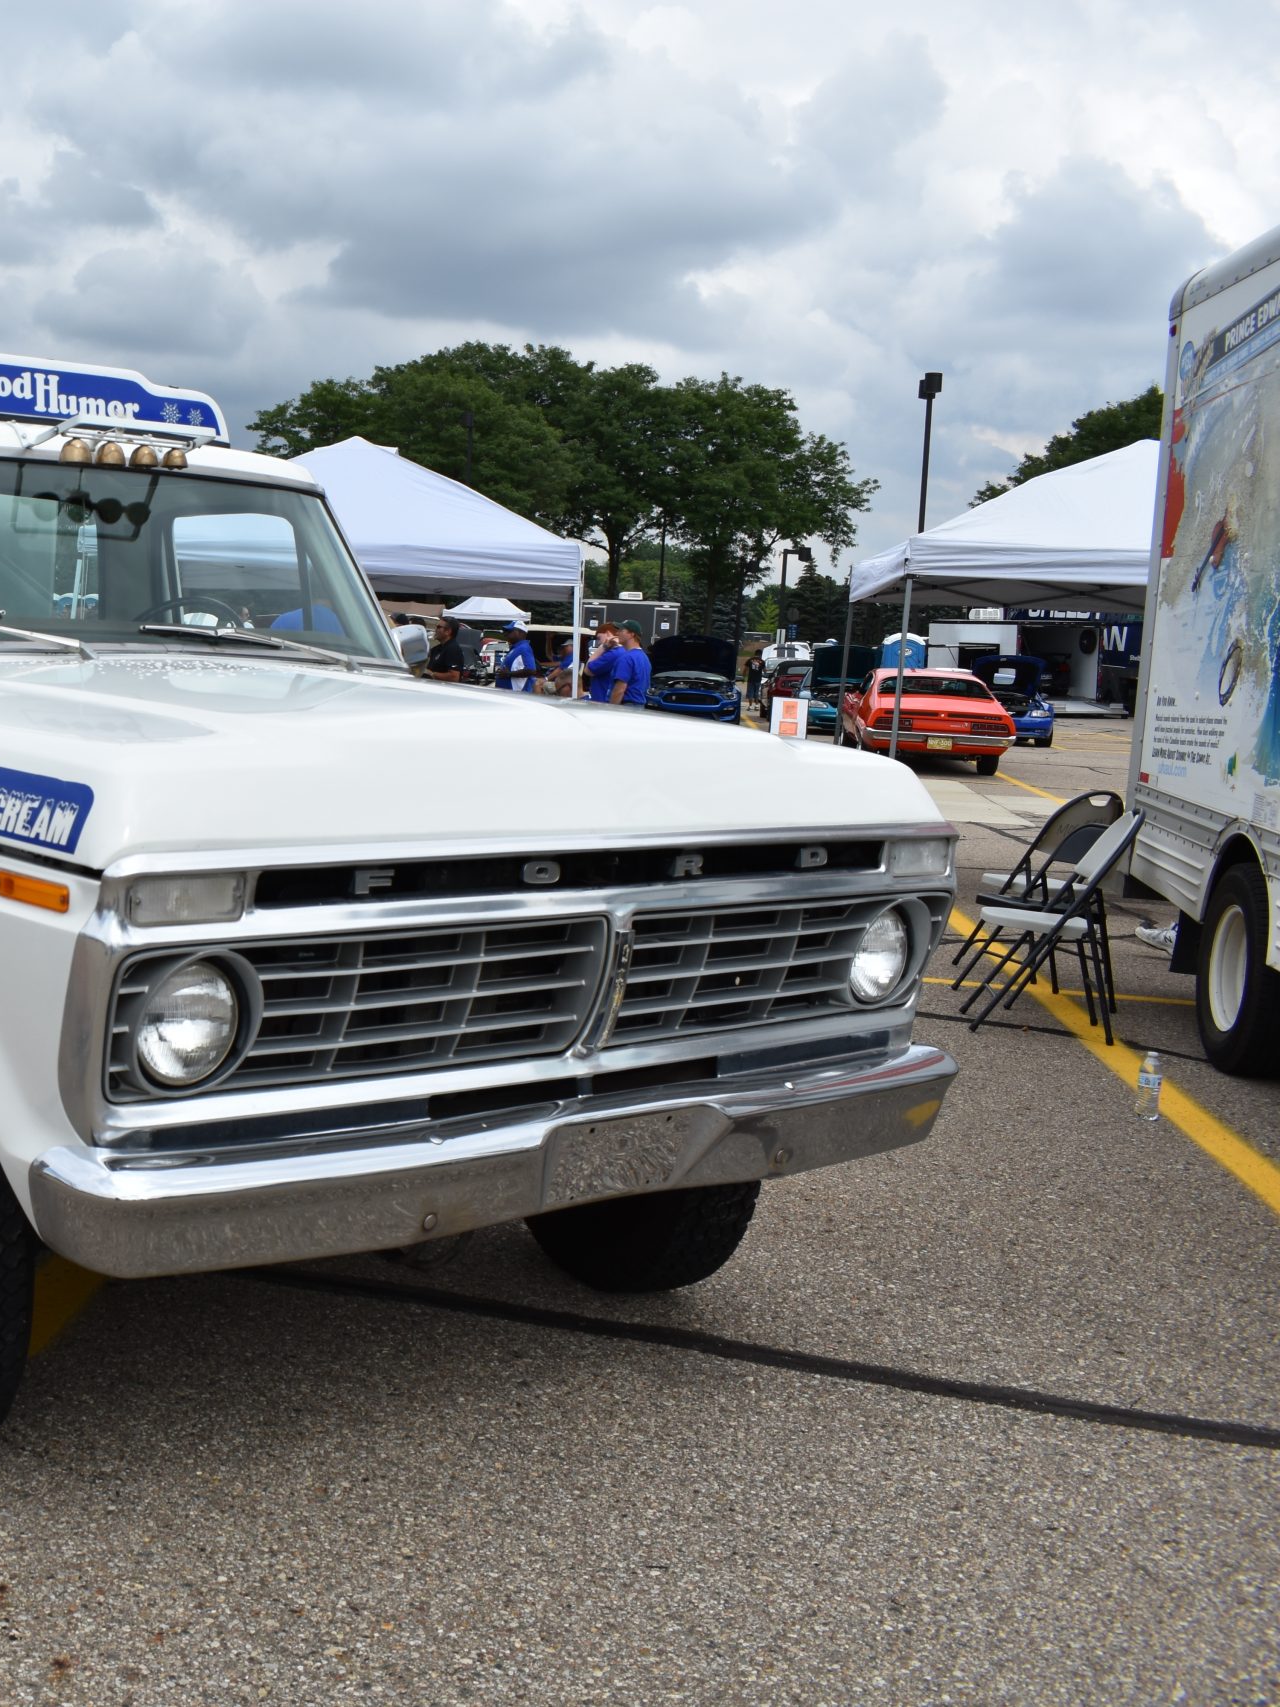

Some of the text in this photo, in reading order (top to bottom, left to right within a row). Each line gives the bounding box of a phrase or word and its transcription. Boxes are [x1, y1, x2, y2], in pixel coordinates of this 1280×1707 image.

[1225, 312, 1256, 353] PRINCE
[33, 373, 140, 419] Humor
[353, 846, 829, 896] FORD
